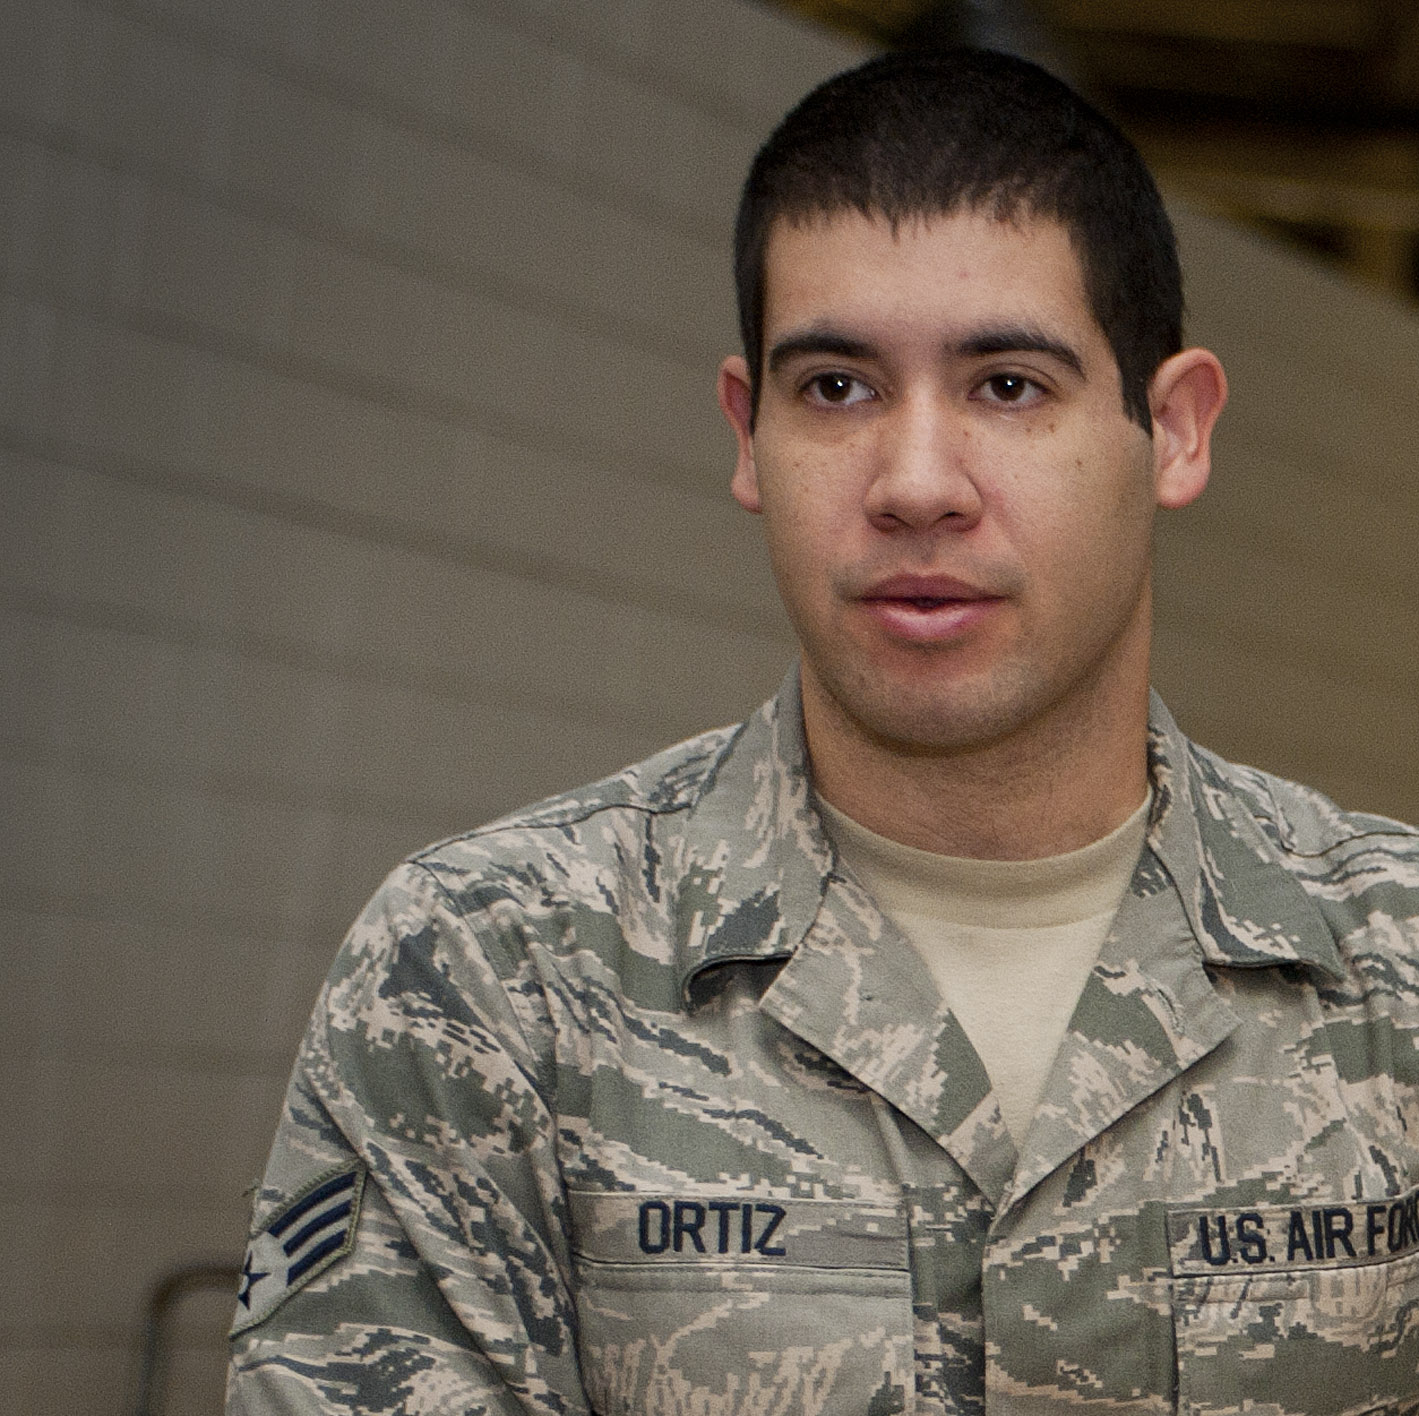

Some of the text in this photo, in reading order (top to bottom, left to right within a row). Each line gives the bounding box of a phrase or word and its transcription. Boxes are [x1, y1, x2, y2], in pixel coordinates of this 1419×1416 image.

[638, 1200, 787, 1256] ORTIZ
[1199, 1212, 1276, 1266] U.S.
[1287, 1206, 1357, 1261] AIR
